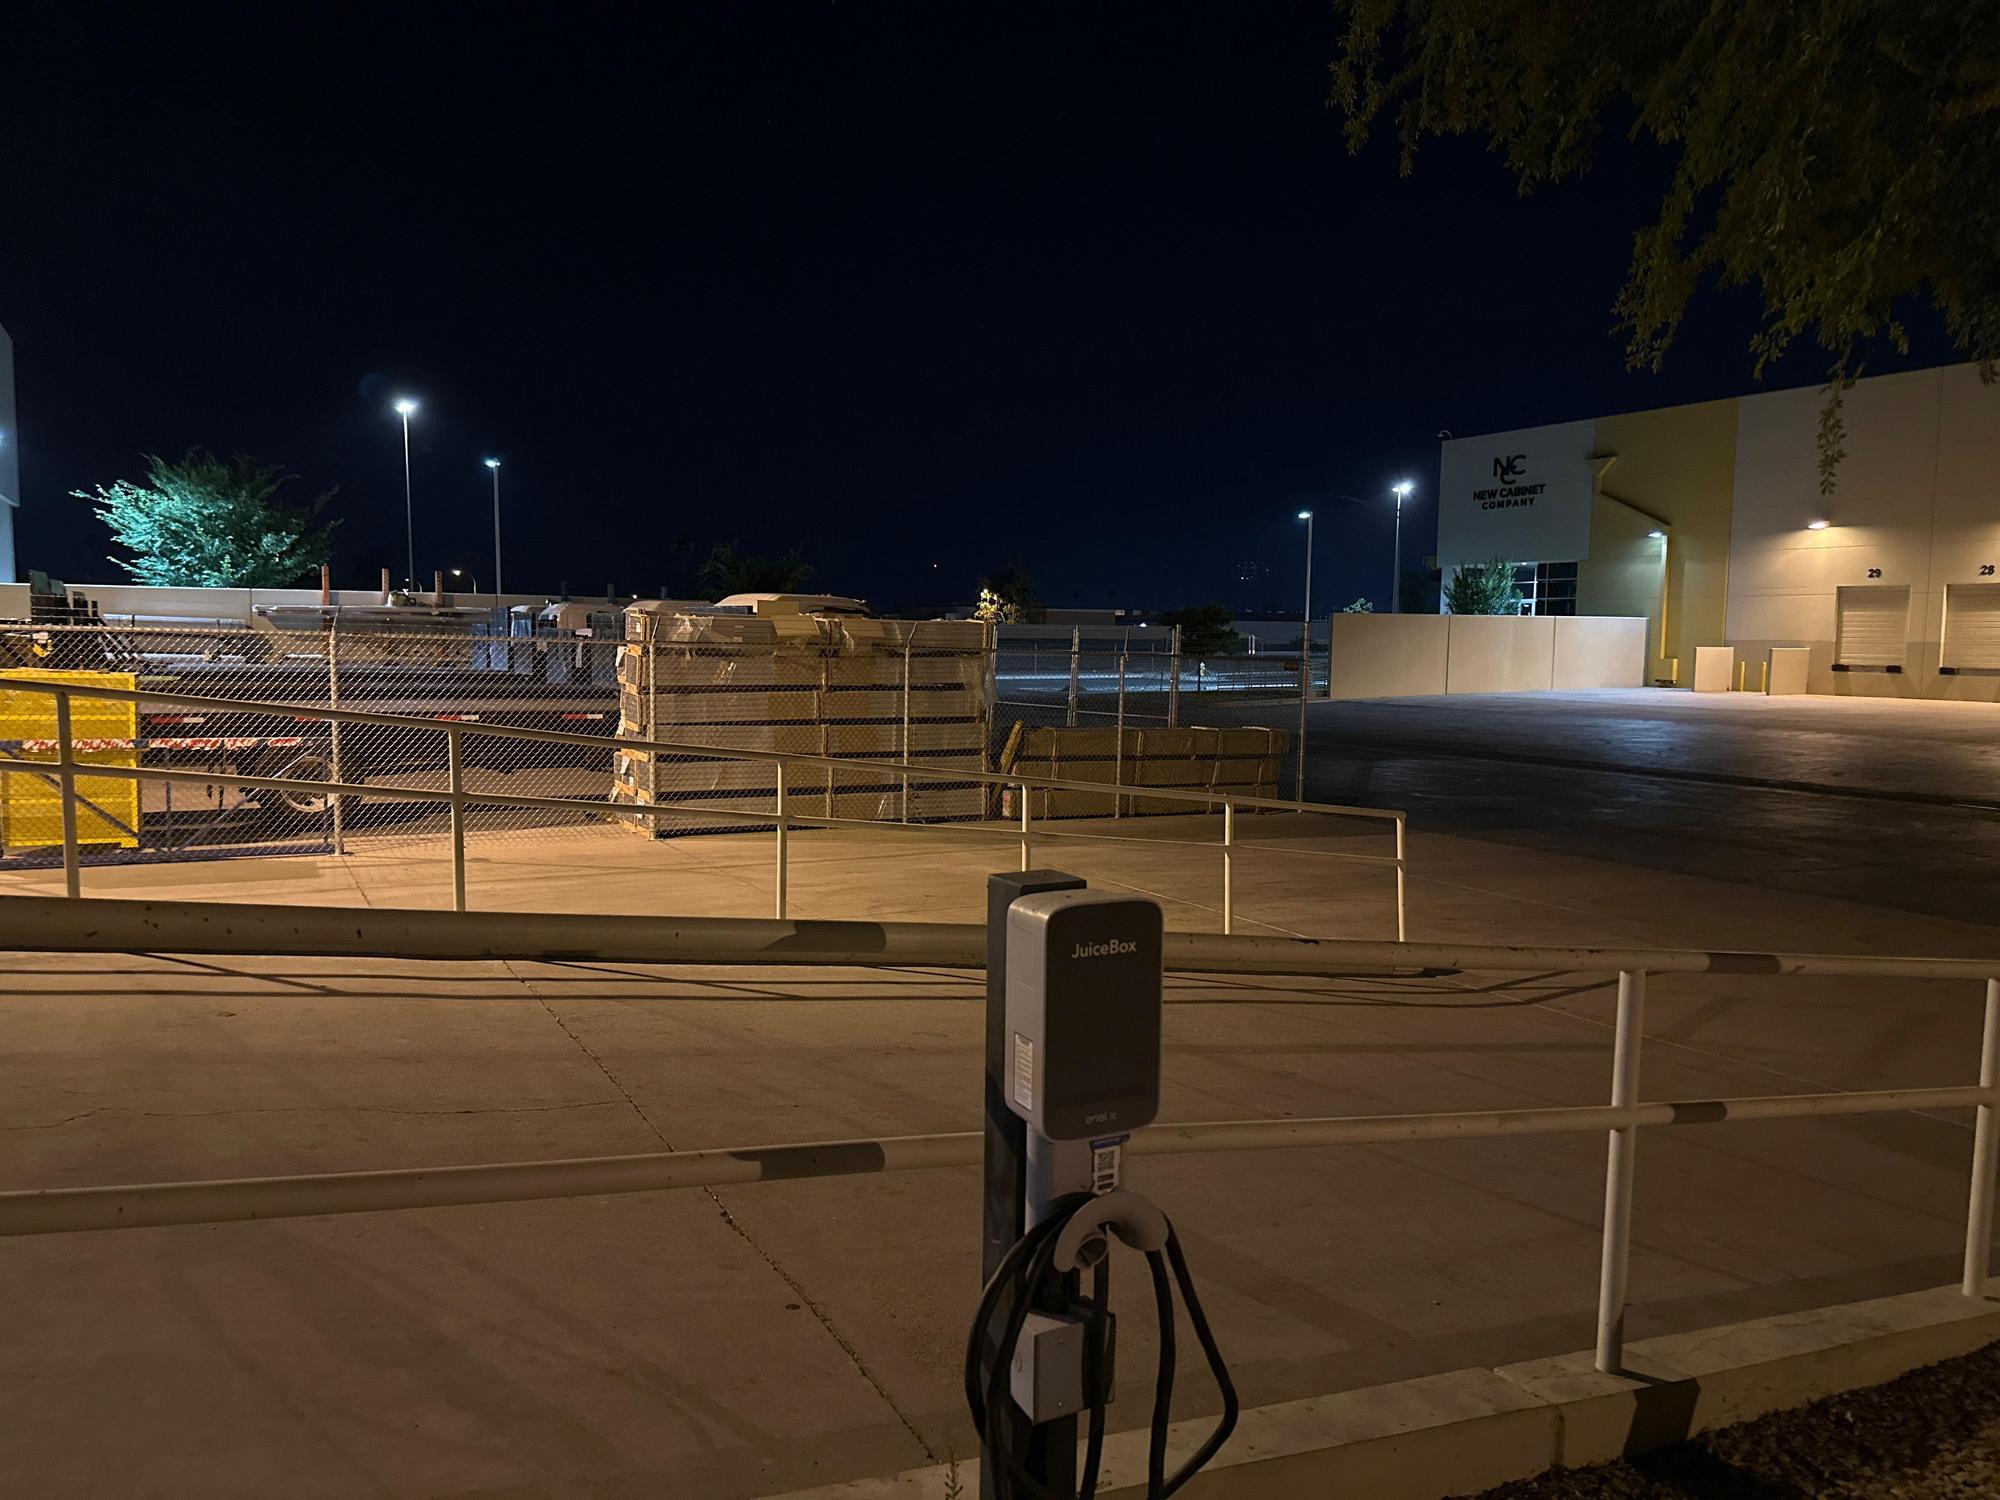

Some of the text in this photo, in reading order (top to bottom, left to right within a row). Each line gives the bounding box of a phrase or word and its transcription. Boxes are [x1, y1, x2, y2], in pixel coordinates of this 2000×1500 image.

[1473, 484, 1545, 501] NEW CABINET
[1482, 498, 1535, 510] COMPANY
[1867, 568, 1881, 578] 29
[1980, 565, 1995, 576] 28
[1071, 939, 1136, 959] JuiceBox
